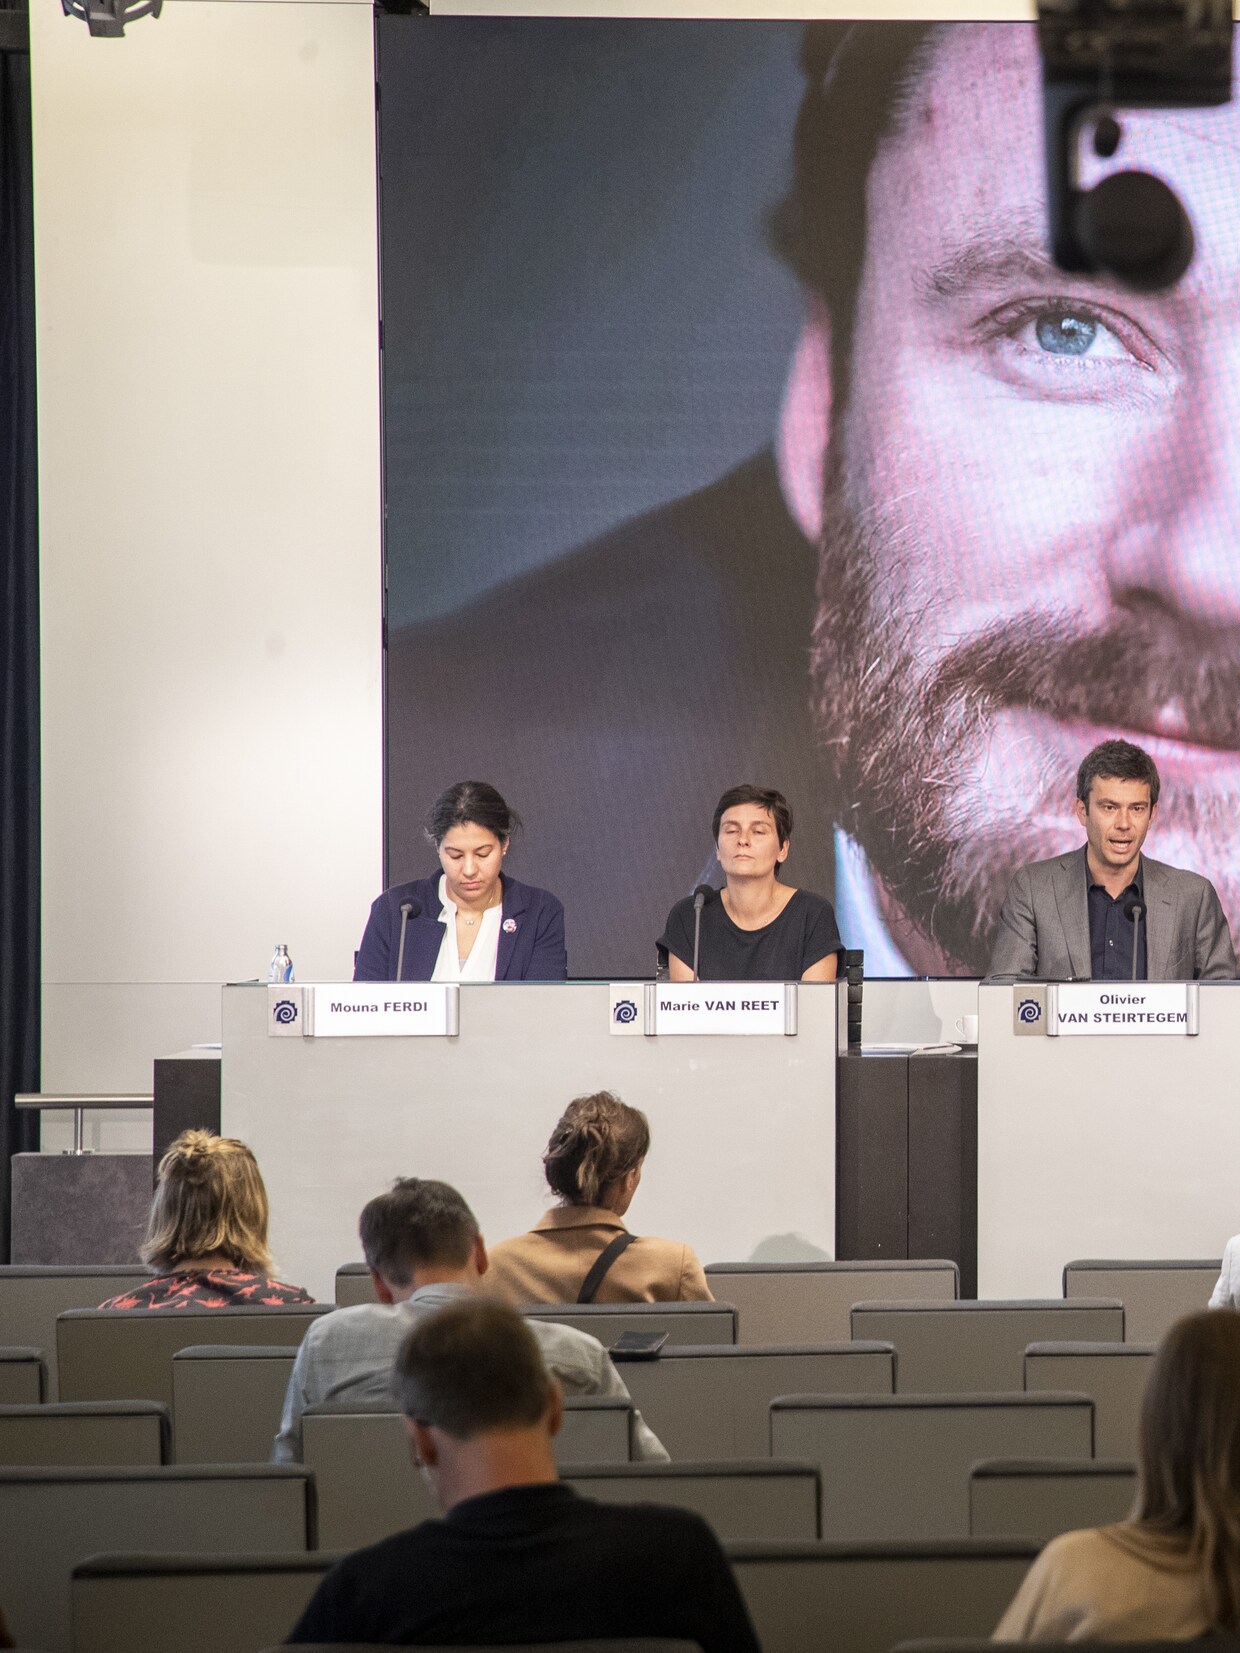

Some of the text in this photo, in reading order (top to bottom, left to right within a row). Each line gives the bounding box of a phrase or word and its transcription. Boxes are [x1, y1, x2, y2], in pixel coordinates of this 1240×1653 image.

[1099, 994, 1147, 1005] Olivier
[330, 1001, 428, 1013] Mouna FERDI
[660, 1000, 780, 1011] Marie VAN REET
[1057, 1012, 1188, 1023] VAN STEIRTEGEM
